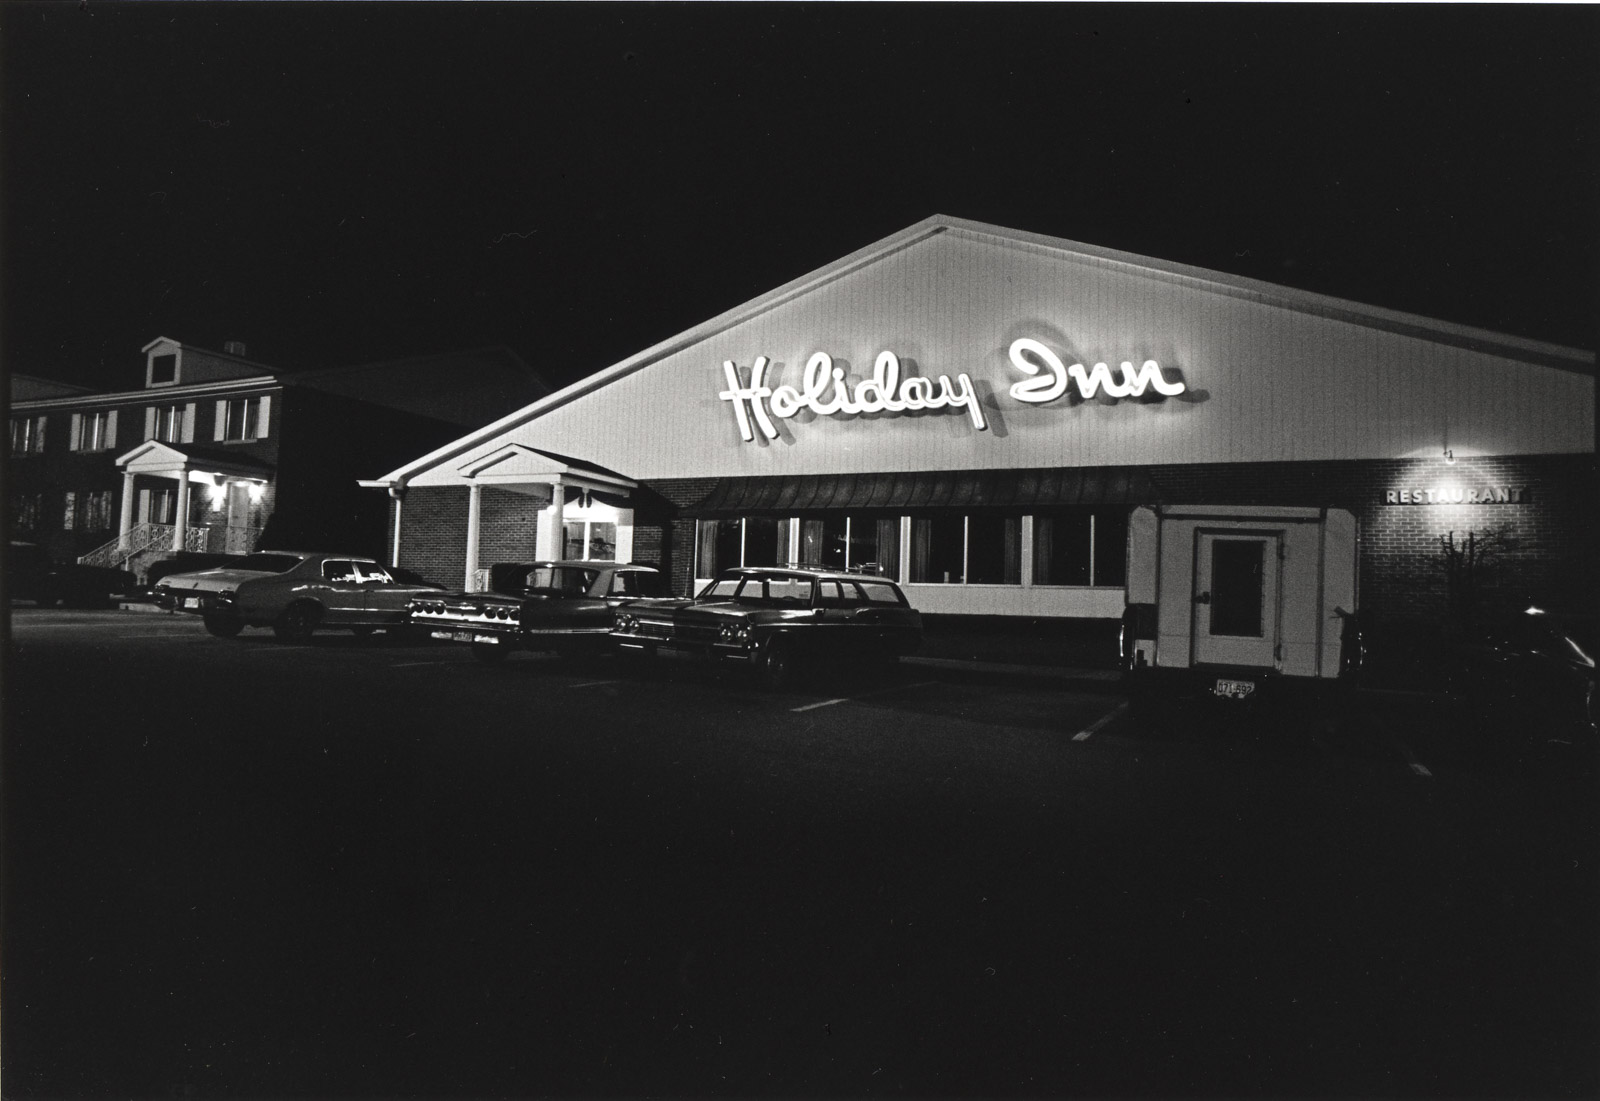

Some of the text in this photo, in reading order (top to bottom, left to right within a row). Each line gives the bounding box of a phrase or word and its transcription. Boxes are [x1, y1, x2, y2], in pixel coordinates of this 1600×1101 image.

[719, 338, 1185, 442] Holiday Inn
[1386, 488, 1524, 504] RESTAURANT
